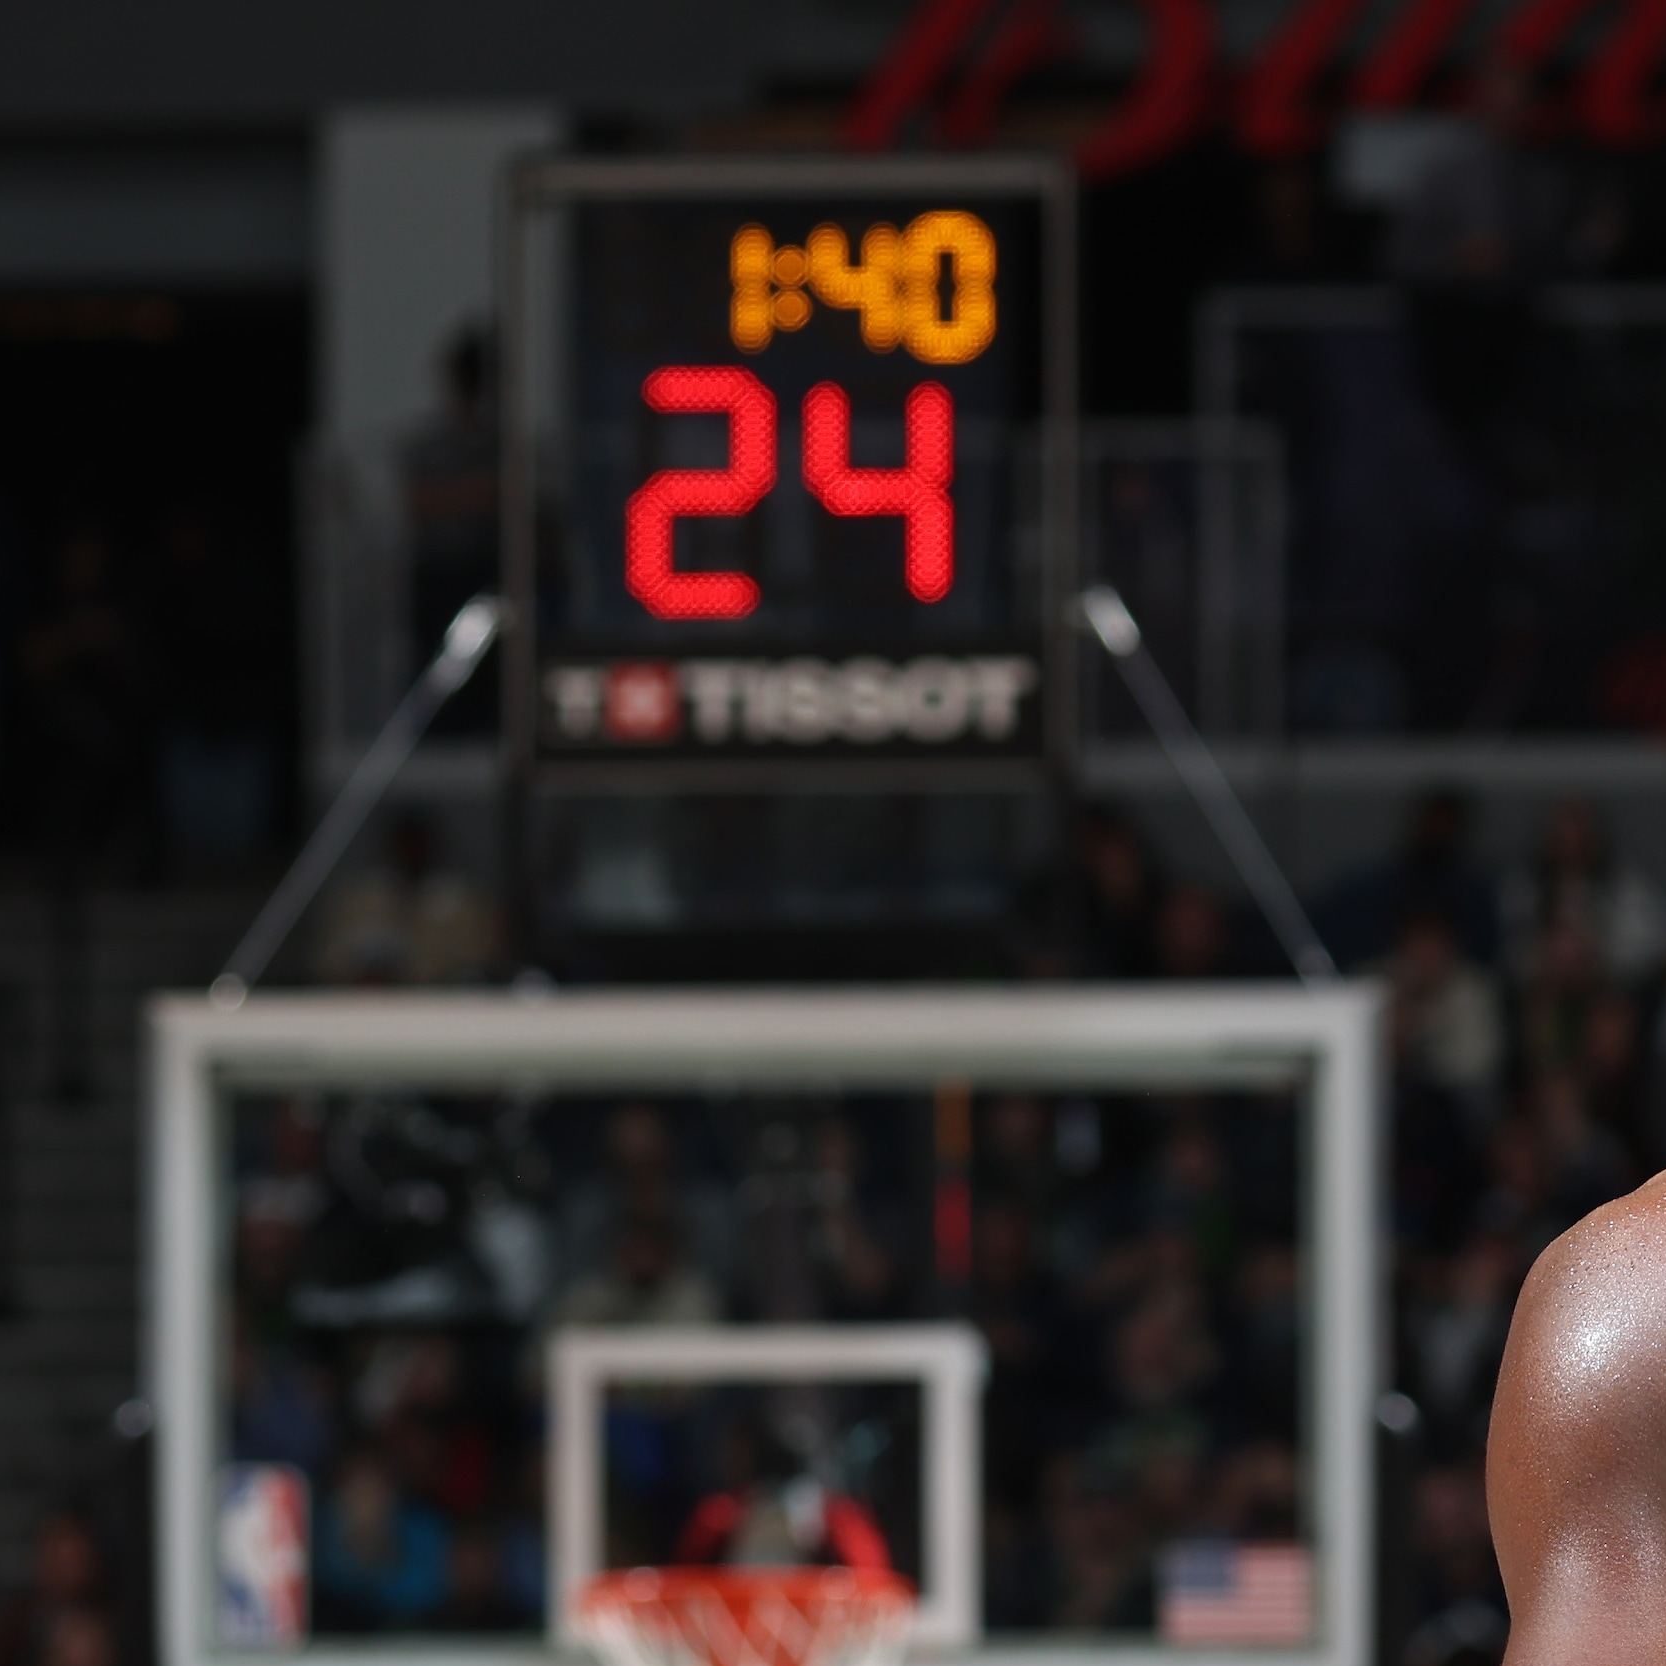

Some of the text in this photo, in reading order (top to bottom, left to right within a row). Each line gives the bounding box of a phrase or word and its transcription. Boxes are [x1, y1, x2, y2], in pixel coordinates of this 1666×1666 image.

[732, 210, 997, 364] 1:40
[625, 366, 954, 620] 24
[687, 657, 1035, 742] TISSOT
